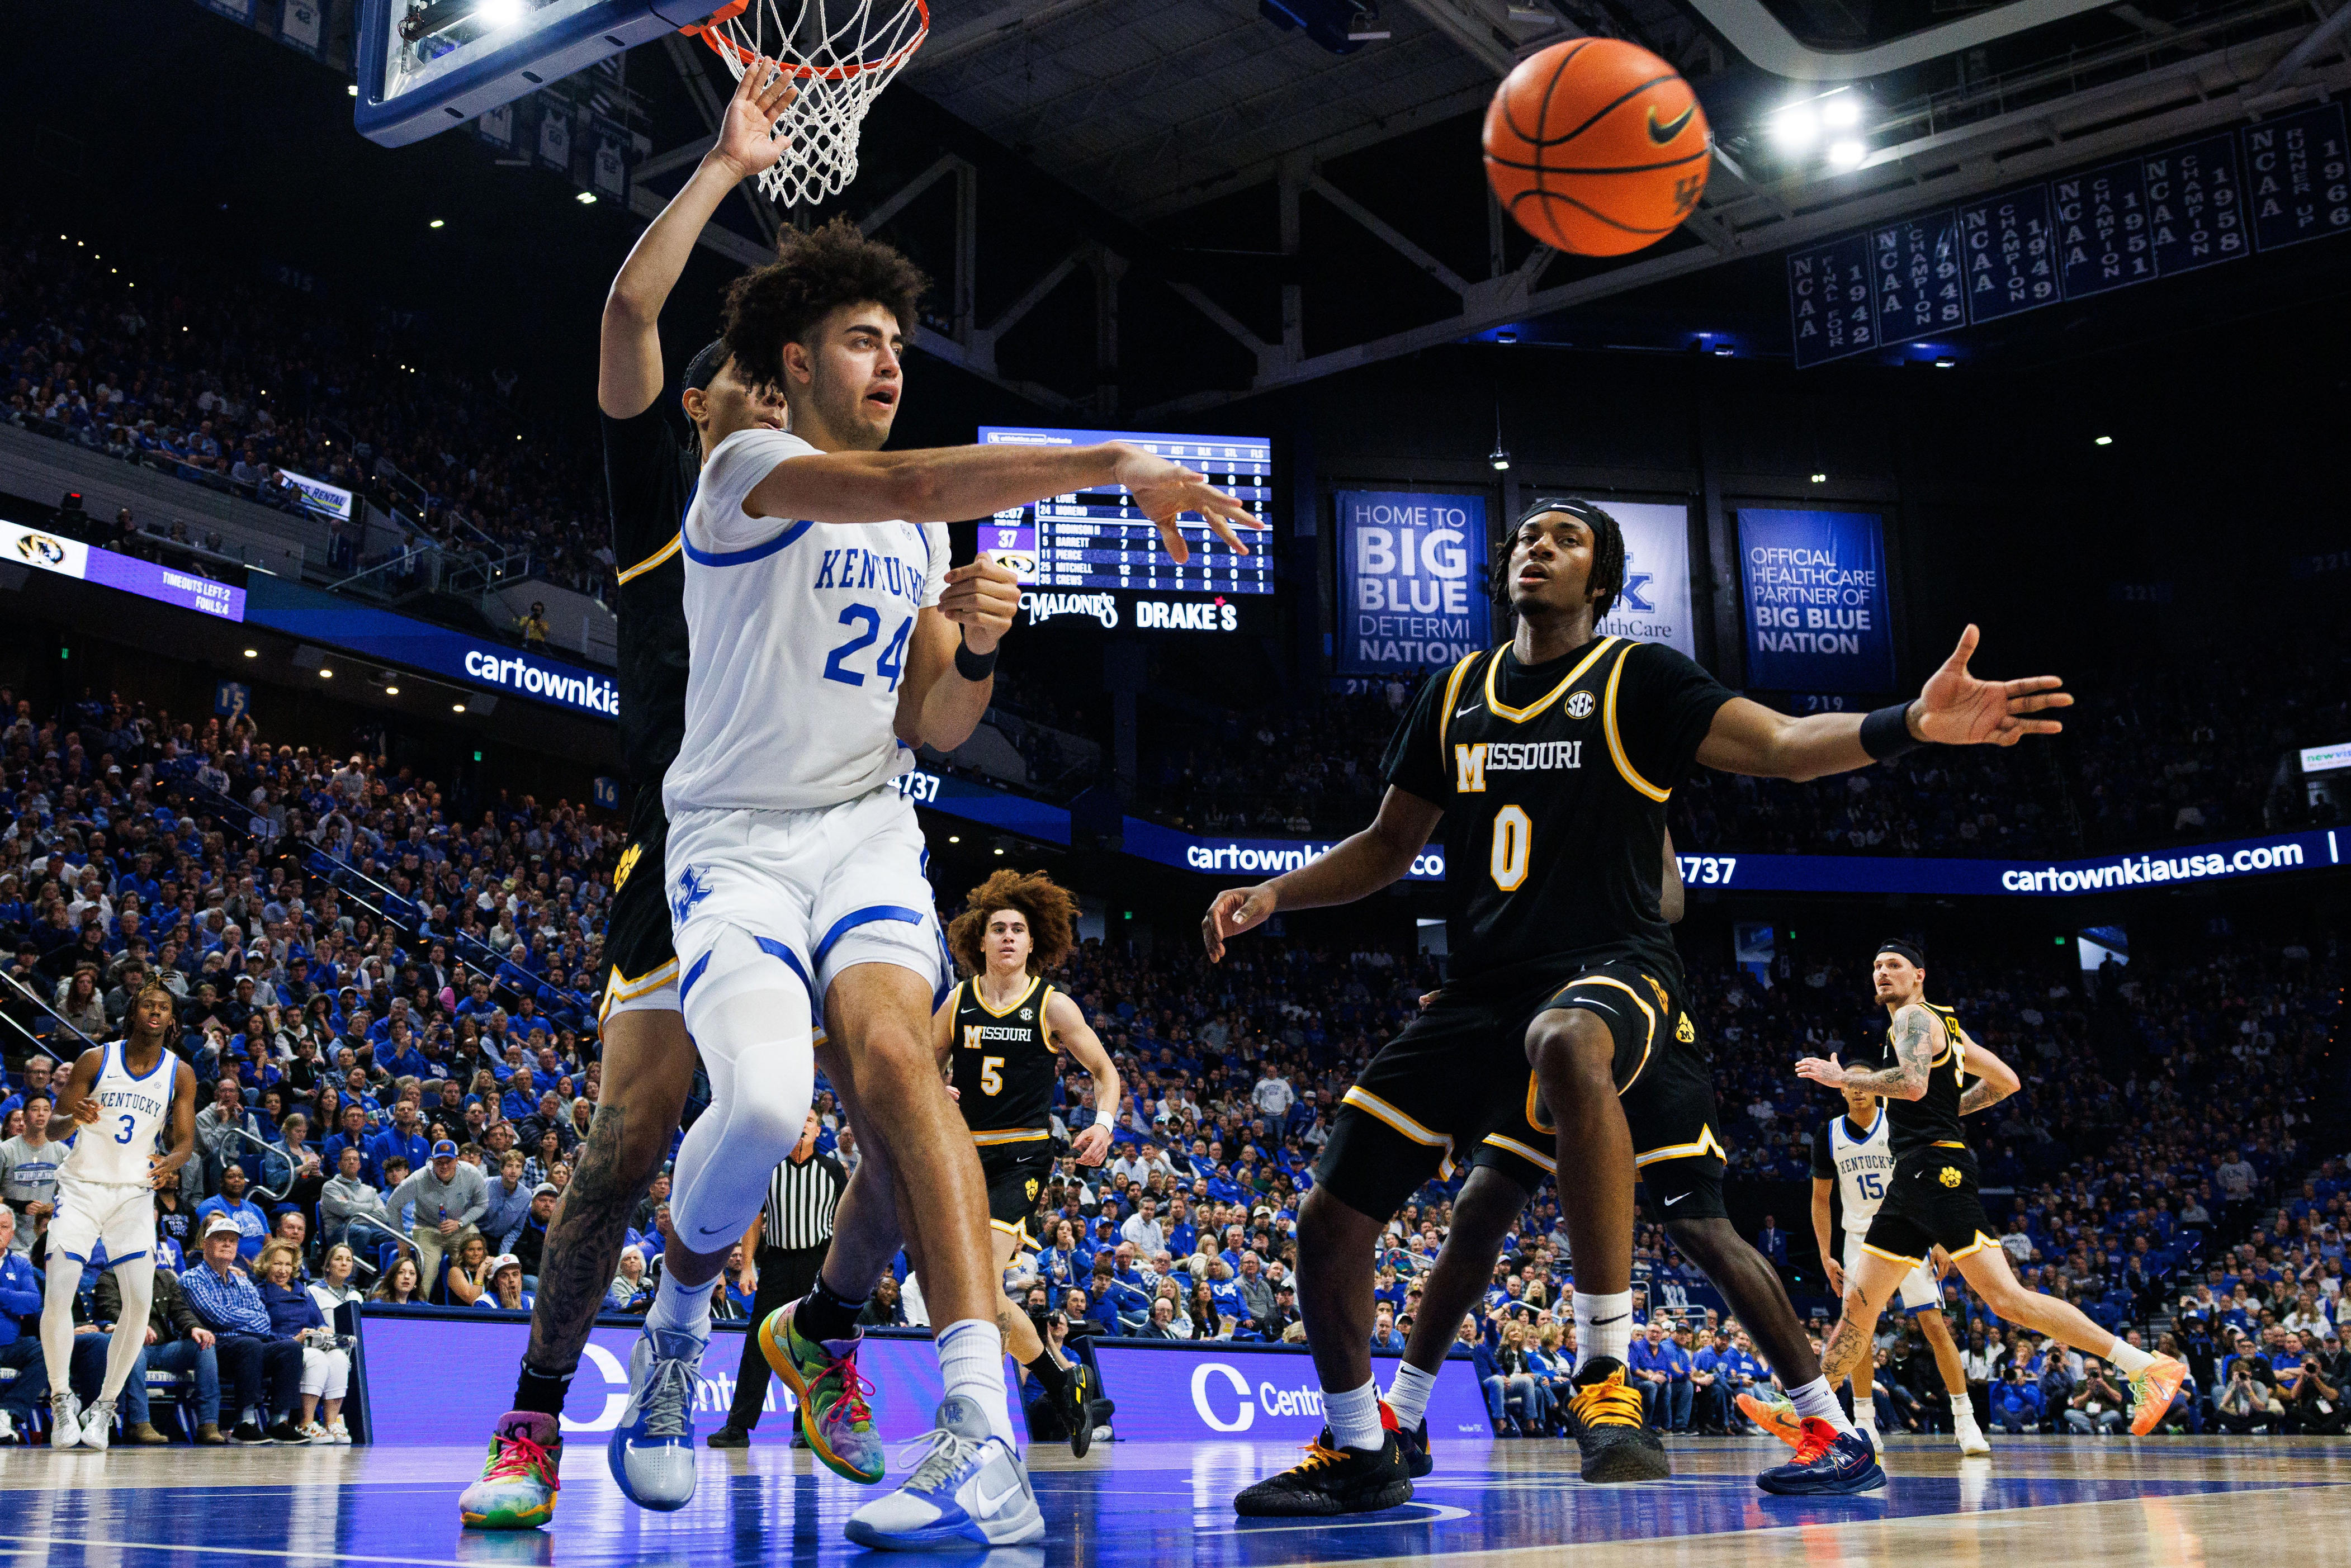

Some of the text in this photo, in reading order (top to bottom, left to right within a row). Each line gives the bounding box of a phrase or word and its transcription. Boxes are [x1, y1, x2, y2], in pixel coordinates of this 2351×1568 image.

[2250, 129, 2283, 219] NCAA
[2322, 139, 2351, 225] 1966
[2147, 159, 2177, 246] NCAA
[2180, 154, 2210, 257] CHAMPION
[2213, 167, 2240, 252] 1958
[2058, 181, 2088, 265] NCAA
[2092, 178, 2120, 278] CHAMPION
[2125, 192, 2148, 274] 1951
[1967, 210, 1994, 292] NCAA
[1999, 204, 2025, 302] CHAMPION
[2027, 219, 2052, 299] 1949
[1878, 231, 1902, 313] NCAA
[1909, 228, 1931, 325] CHAMPION
[1935, 242, 1960, 321] 1948
[1792, 257, 1817, 337] NCAA
[1849, 264, 1870, 343] 1942
[1171, 446, 1184, 455] AST
[1251, 449, 1264, 458] FLS
[1228, 462, 1234, 472] 3
[1254, 463, 1261, 473] 2
[1254, 476, 1261, 486] 0
[311, 487, 347, 506] RENTAL
[1120, 496, 1128, 505] 4
[1255, 501, 1262, 511] 2
[1255, 489, 1261, 498] 1
[1040, 505, 1051, 515] 24
[1055, 505, 1087, 517] MORENO
[1120, 508, 1128, 518] 4
[1356, 505, 1466, 527] HOME TO
[998, 530, 1018, 548] 37
[1042, 536, 1262, 555] 5 BARRETT 7 0 0 1
[1120, 526, 1128, 536] 7
[1148, 527, 1156, 537] 2
[1203, 529, 1210, 539] 0
[1256, 532, 1262, 542] 1
[1041, 549, 1264, 567] 11 PIERCE 3 2 0 3 2
[1357, 527, 1467, 579] BIG
[1751, 547, 1836, 566] OFFICIAL
[163, 571, 203, 594] TIMEOUTS
[1040, 562, 1263, 580] 25 MITCHELL 12 1 2 0 0 1
[1752, 567, 1876, 587] HEALTHCARE
[1040, 574, 1264, 593] 35 CREWS 0 0 0 0 1 1
[1358, 577, 1469, 614] BLUE
[1754, 586, 1870, 606] PARTNER OF
[1018, 592, 1118, 628] MALONE'S
[1756, 607, 1871, 631] BIG BLUE
[1359, 615, 1470, 639] DETERMI
[823, 603, 914, 693] 24
[1758, 631, 1859, 655] NATION
[221, 687, 245, 709] 15
[1567, 692, 1593, 717] SEC
[1808, 695, 1843, 711] 219
[1455, 741, 1582, 793] MISSOURI
[594, 778, 614, 802] 16
[1491, 804, 1532, 891] 0
[2002, 843, 2303, 892] cartownkiausa.com
[1020, 1008, 1033, 1021] SEC
[964, 1025, 1032, 1049] MISSOURI
[981, 1056, 1005, 1096] 5
[101, 1093, 161, 1117] KENTUCKY
[114, 1114, 135, 1144] 3
[1839, 1155, 1895, 1174] KENTUCKY
[1857, 1173, 1885, 1200] 15
[1260, 1381, 1323, 1417] Centr
